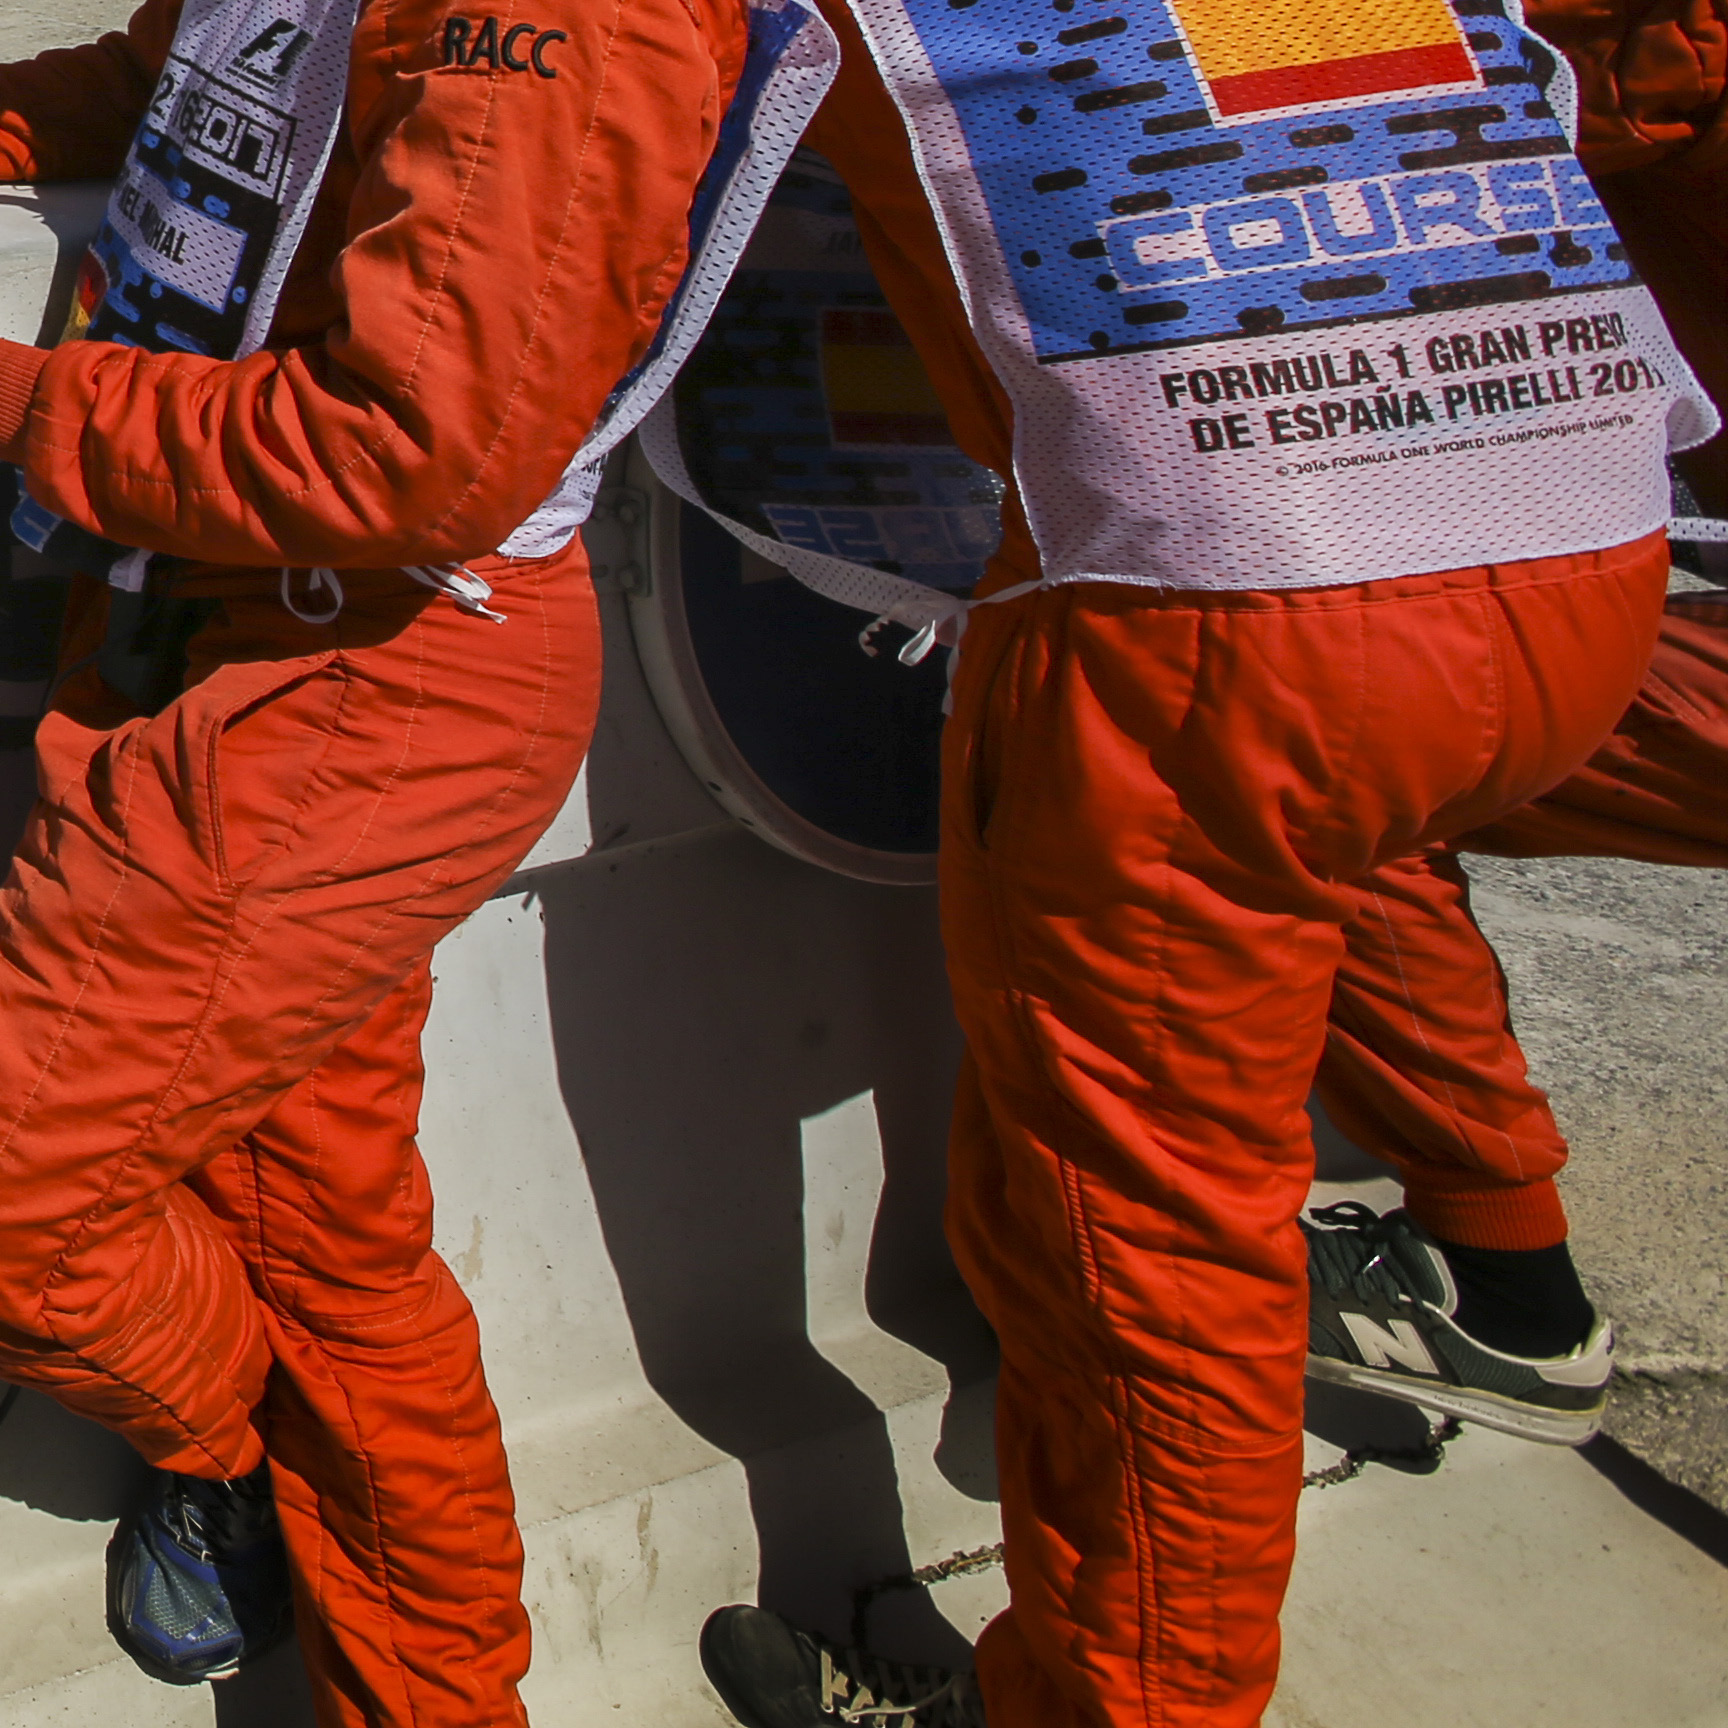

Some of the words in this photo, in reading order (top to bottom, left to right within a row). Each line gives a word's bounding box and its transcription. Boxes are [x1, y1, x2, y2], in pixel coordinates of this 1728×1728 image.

[444, 16, 568, 79] RACC
[1159, 348, 1379, 408] FORMULA
[1387, 343, 1412, 379] 1
[1425, 319, 1529, 374] GRAN
[1189, 412, 1255, 454] DE
[1268, 385, 1434, 445] ESPAÑA
[1444, 367, 1583, 420] PIRELLI
[1332, 450, 1398, 470] FORMULA
[1402, 445, 1430, 458] ONE
[1433, 437, 1485, 454] WORLD
[1489, 421, 1587, 446] CHAMPIONSHIP
[1588, 414, 1634, 430] LIMITED
[1339, 1312, 1440, 1375] N
